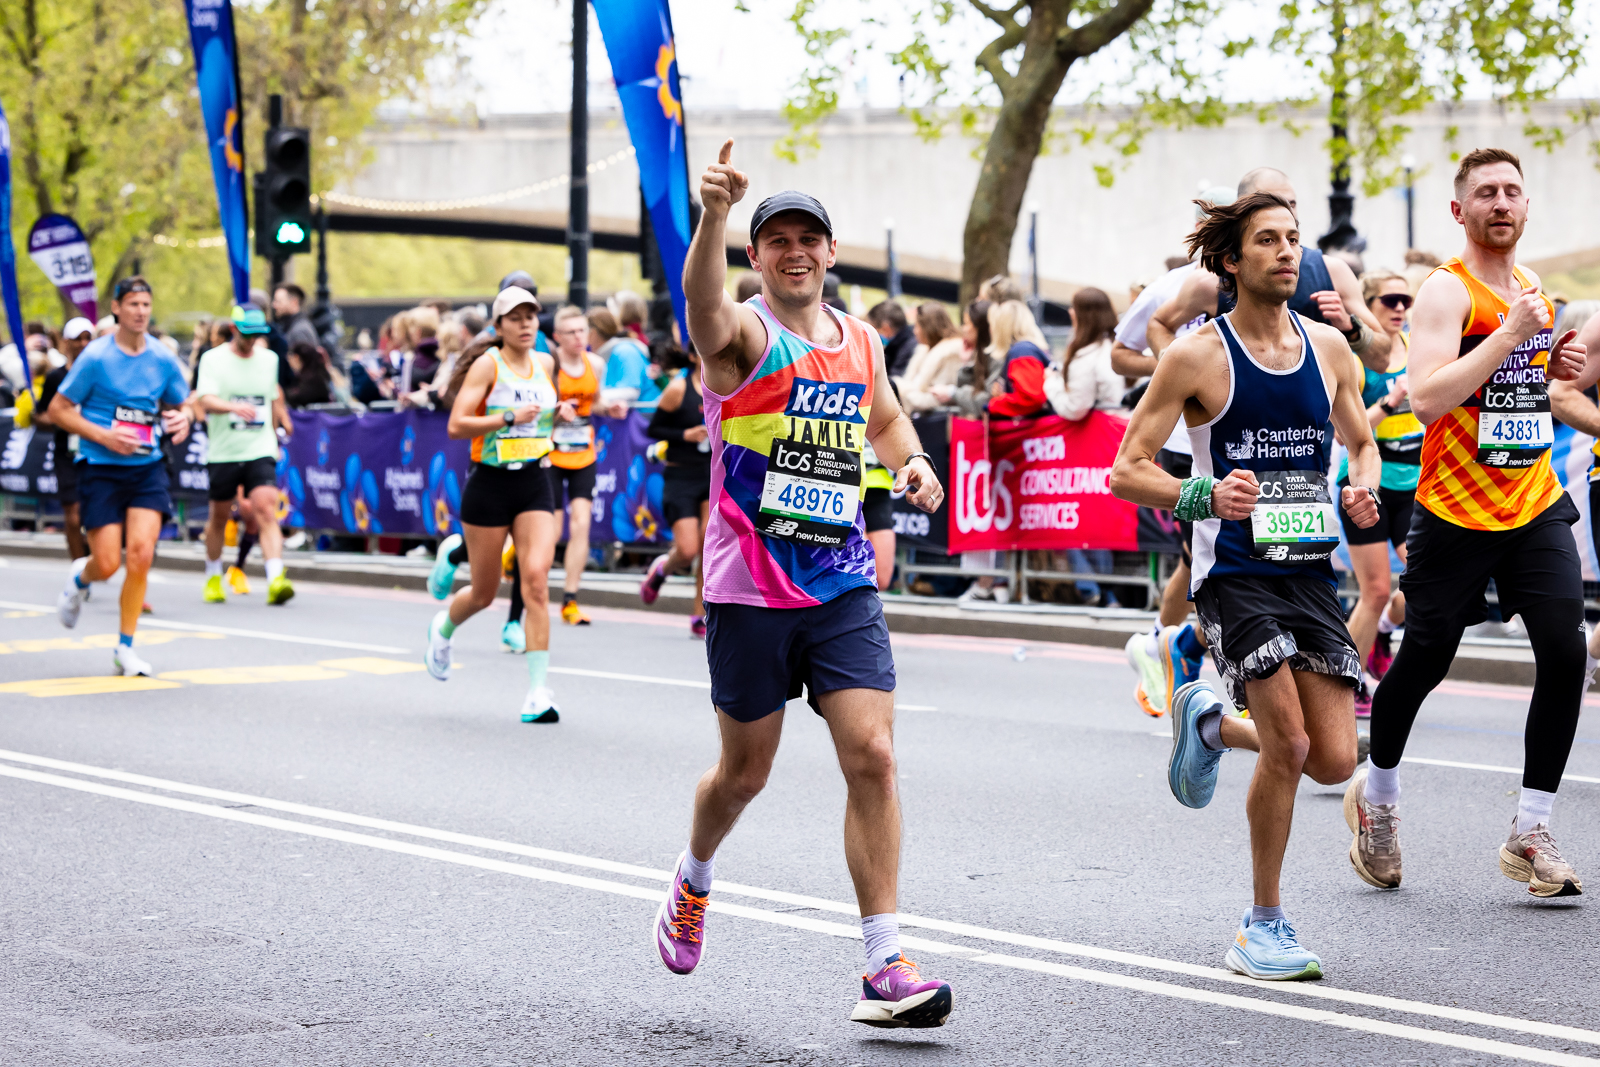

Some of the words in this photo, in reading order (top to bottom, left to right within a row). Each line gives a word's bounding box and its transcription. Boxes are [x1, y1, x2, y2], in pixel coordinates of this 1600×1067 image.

[1493, 368, 1545, 384] CANCER
[792, 384, 858, 416] Kids
[1485, 387, 1514, 408] tcs
[787, 417, 855, 448] JAMIE
[1492, 420, 1540, 440] 43831
[776, 444, 812, 471] tcs
[817, 450, 835, 460] TATA
[1257, 442, 1315, 458] Harriers
[813, 467, 841, 477] SERVICES
[815, 458, 858, 471] CONSULTANCY
[956, 440, 1015, 534] tcs
[1020, 467, 1112, 495] CONSULTANC
[1257, 481, 1284, 498] cs
[778, 483, 844, 516] 48976
[1019, 501, 1080, 530] SERVICES
[1266, 511, 1325, 534] 39521
[796, 532, 813, 541] new
[814, 533, 841, 544] balance
